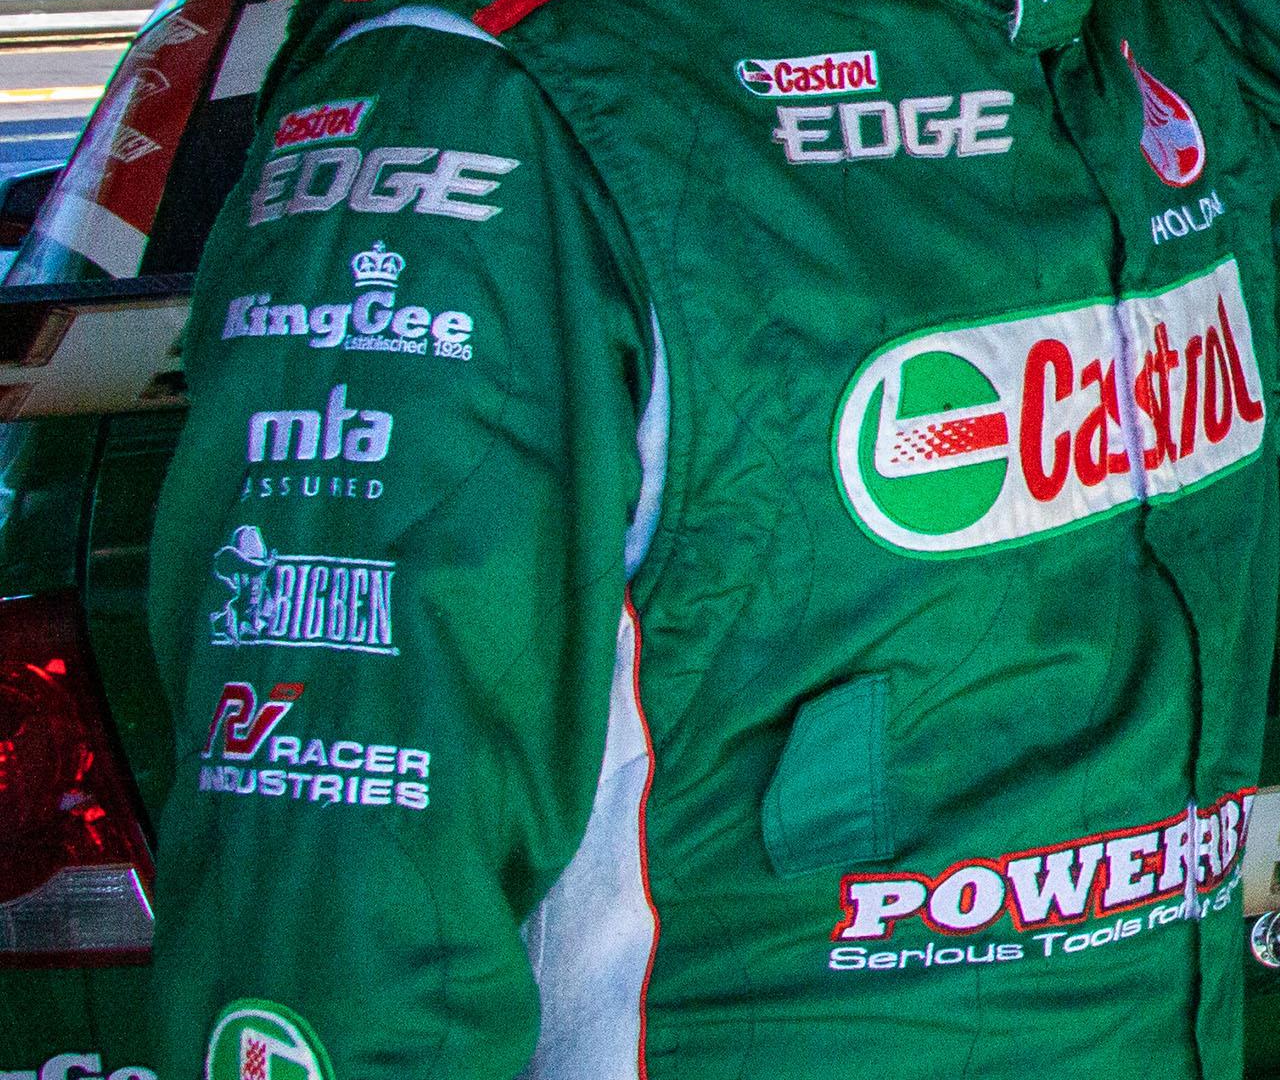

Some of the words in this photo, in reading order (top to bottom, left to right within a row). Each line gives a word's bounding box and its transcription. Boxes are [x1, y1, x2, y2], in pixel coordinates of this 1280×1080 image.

[774, 54, 876, 93] Castrol
[773, 90, 1014, 166] EDGE
[249, 147, 520, 226] EDGE
[433, 340, 474, 362] 1926
[1019, 293, 1264, 503] Castrol
[268, 736, 431, 778] RACER
[200, 765, 431, 810] INDUSTRIES
[828, 942, 1024, 971] Serious
[1033, 917, 1143, 958] Tools
